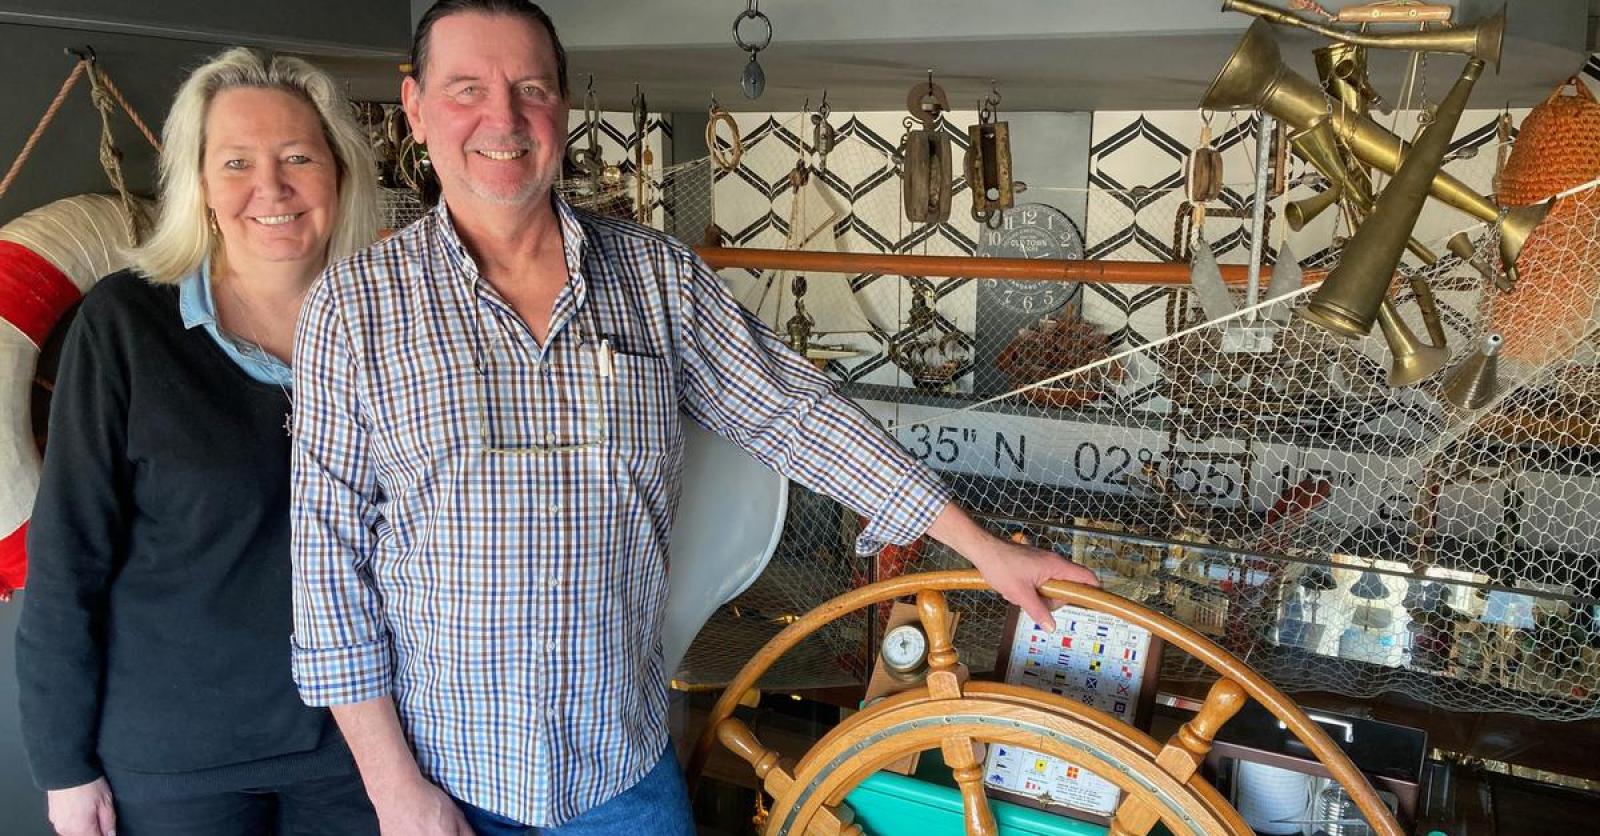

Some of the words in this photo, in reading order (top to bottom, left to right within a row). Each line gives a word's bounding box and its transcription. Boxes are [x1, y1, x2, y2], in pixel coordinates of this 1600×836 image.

[1004, 215, 1013, 230] 11
[1021, 210, 1038, 225] 12
[1047, 213, 1056, 230] 1
[987, 231, 1001, 246] 10
[1060, 231, 1072, 248] 2
[1003, 290, 1014, 306] 7
[1023, 295, 1033, 310] 6
[1043, 290, 1054, 305] 5
[995, 431, 1026, 473] N
